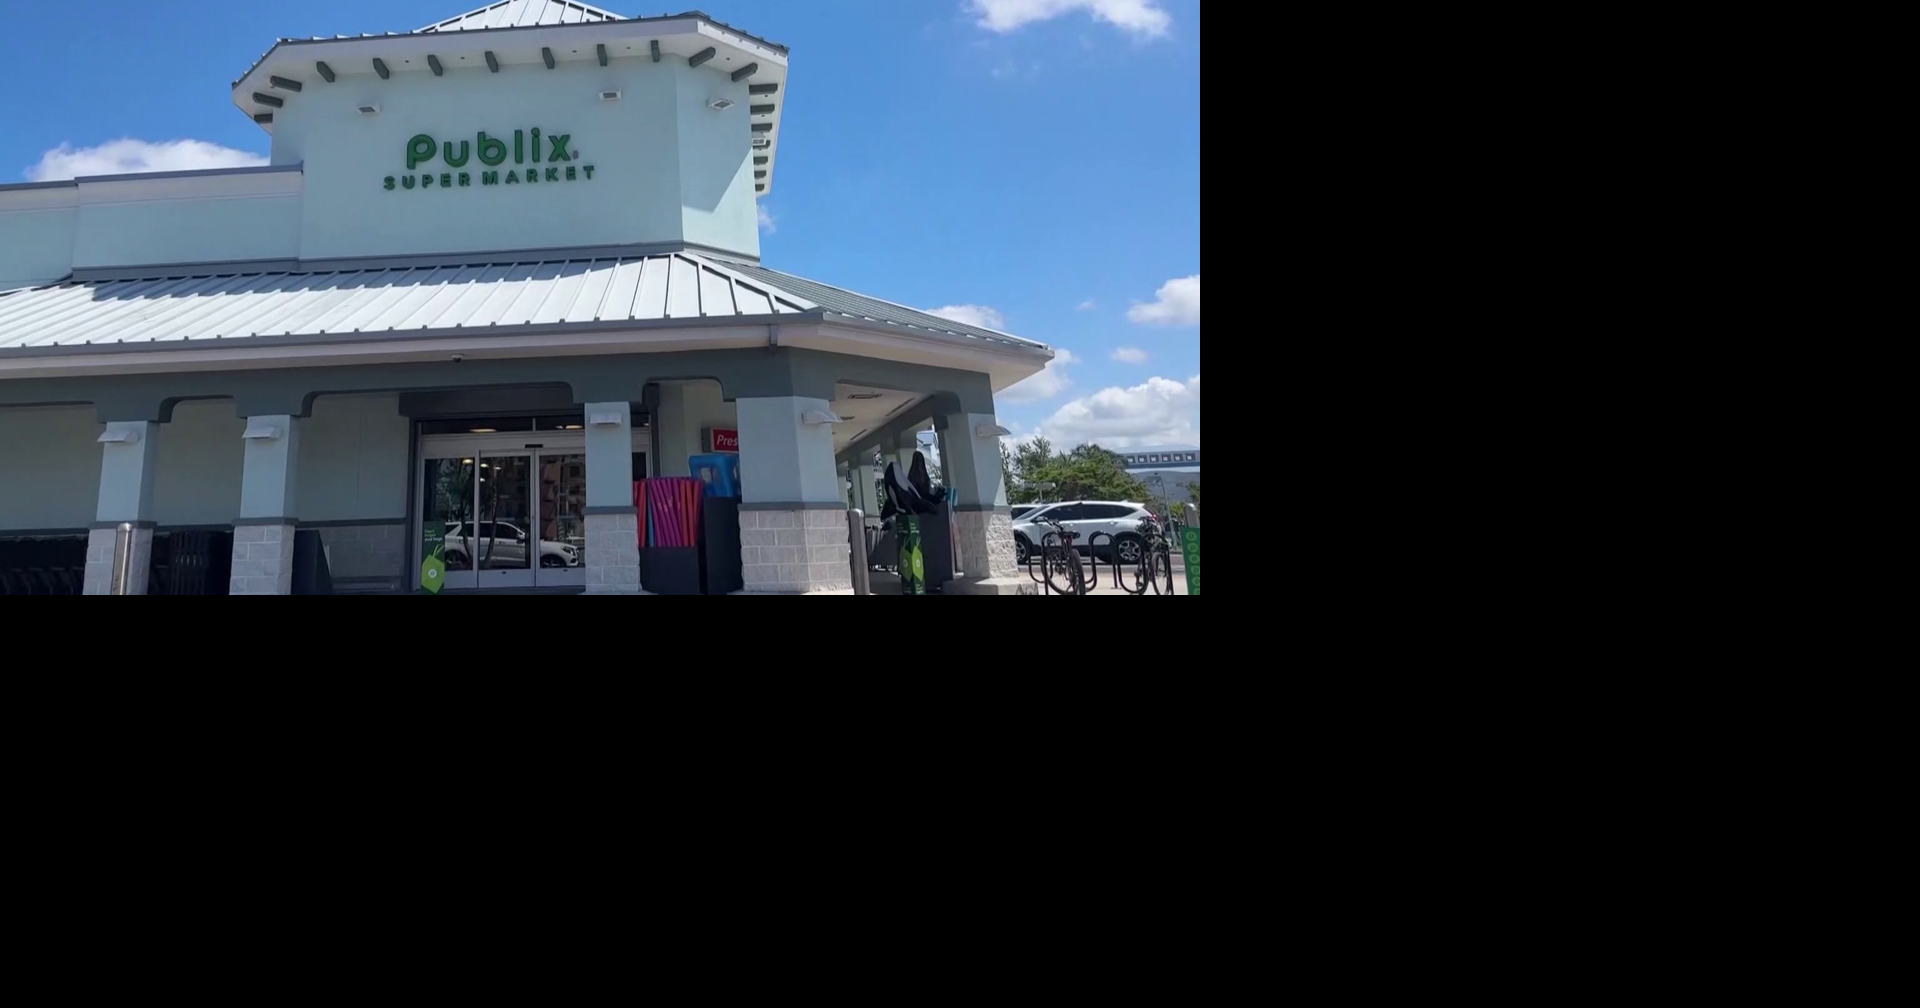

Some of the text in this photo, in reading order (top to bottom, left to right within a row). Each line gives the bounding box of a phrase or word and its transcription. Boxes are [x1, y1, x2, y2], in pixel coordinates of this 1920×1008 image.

[406, 127, 571, 170] Publix
[383, 165, 595, 191] SUPER MARKET
